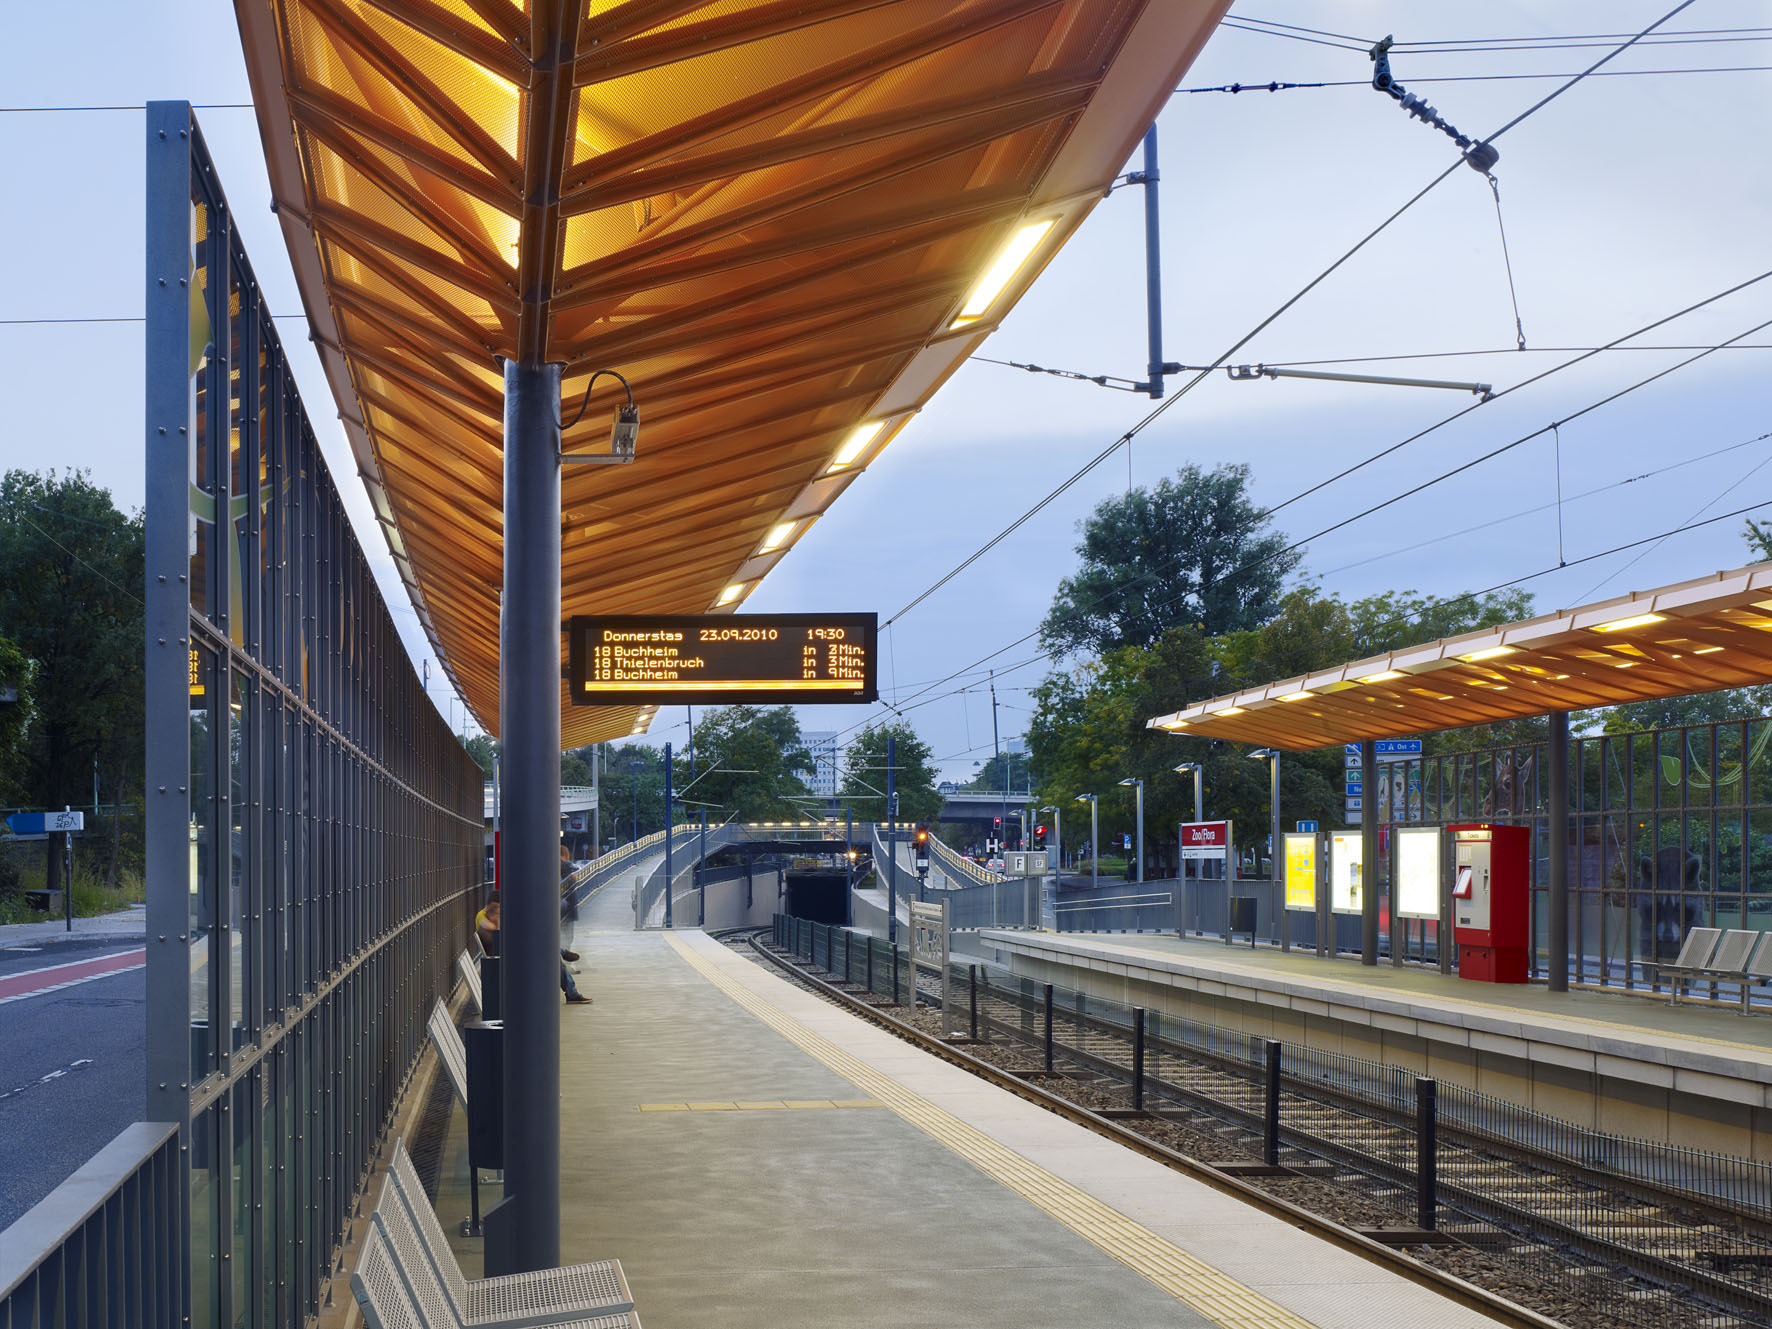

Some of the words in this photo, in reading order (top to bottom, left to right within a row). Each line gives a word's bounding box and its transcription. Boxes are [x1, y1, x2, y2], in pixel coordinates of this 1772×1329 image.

[603, 630, 683, 641] Donnerstag
[699, 629, 778, 641] 23.09.2010
[807, 628, 845, 640] 19:30
[594, 646, 611, 656] 18
[614, 646, 678, 656] Buchheim
[803, 645, 816, 655] in
[594, 657, 611, 668] 18
[614, 657, 704, 668] Thielenbruch
[803, 656, 816, 667] in
[594, 669, 611, 680] 18
[614, 669, 678, 680] Buchheim
[803, 668, 816, 678] in
[1192, 828, 1216, 840] Zoo/Flora
[1016, 858, 1023, 869] F
